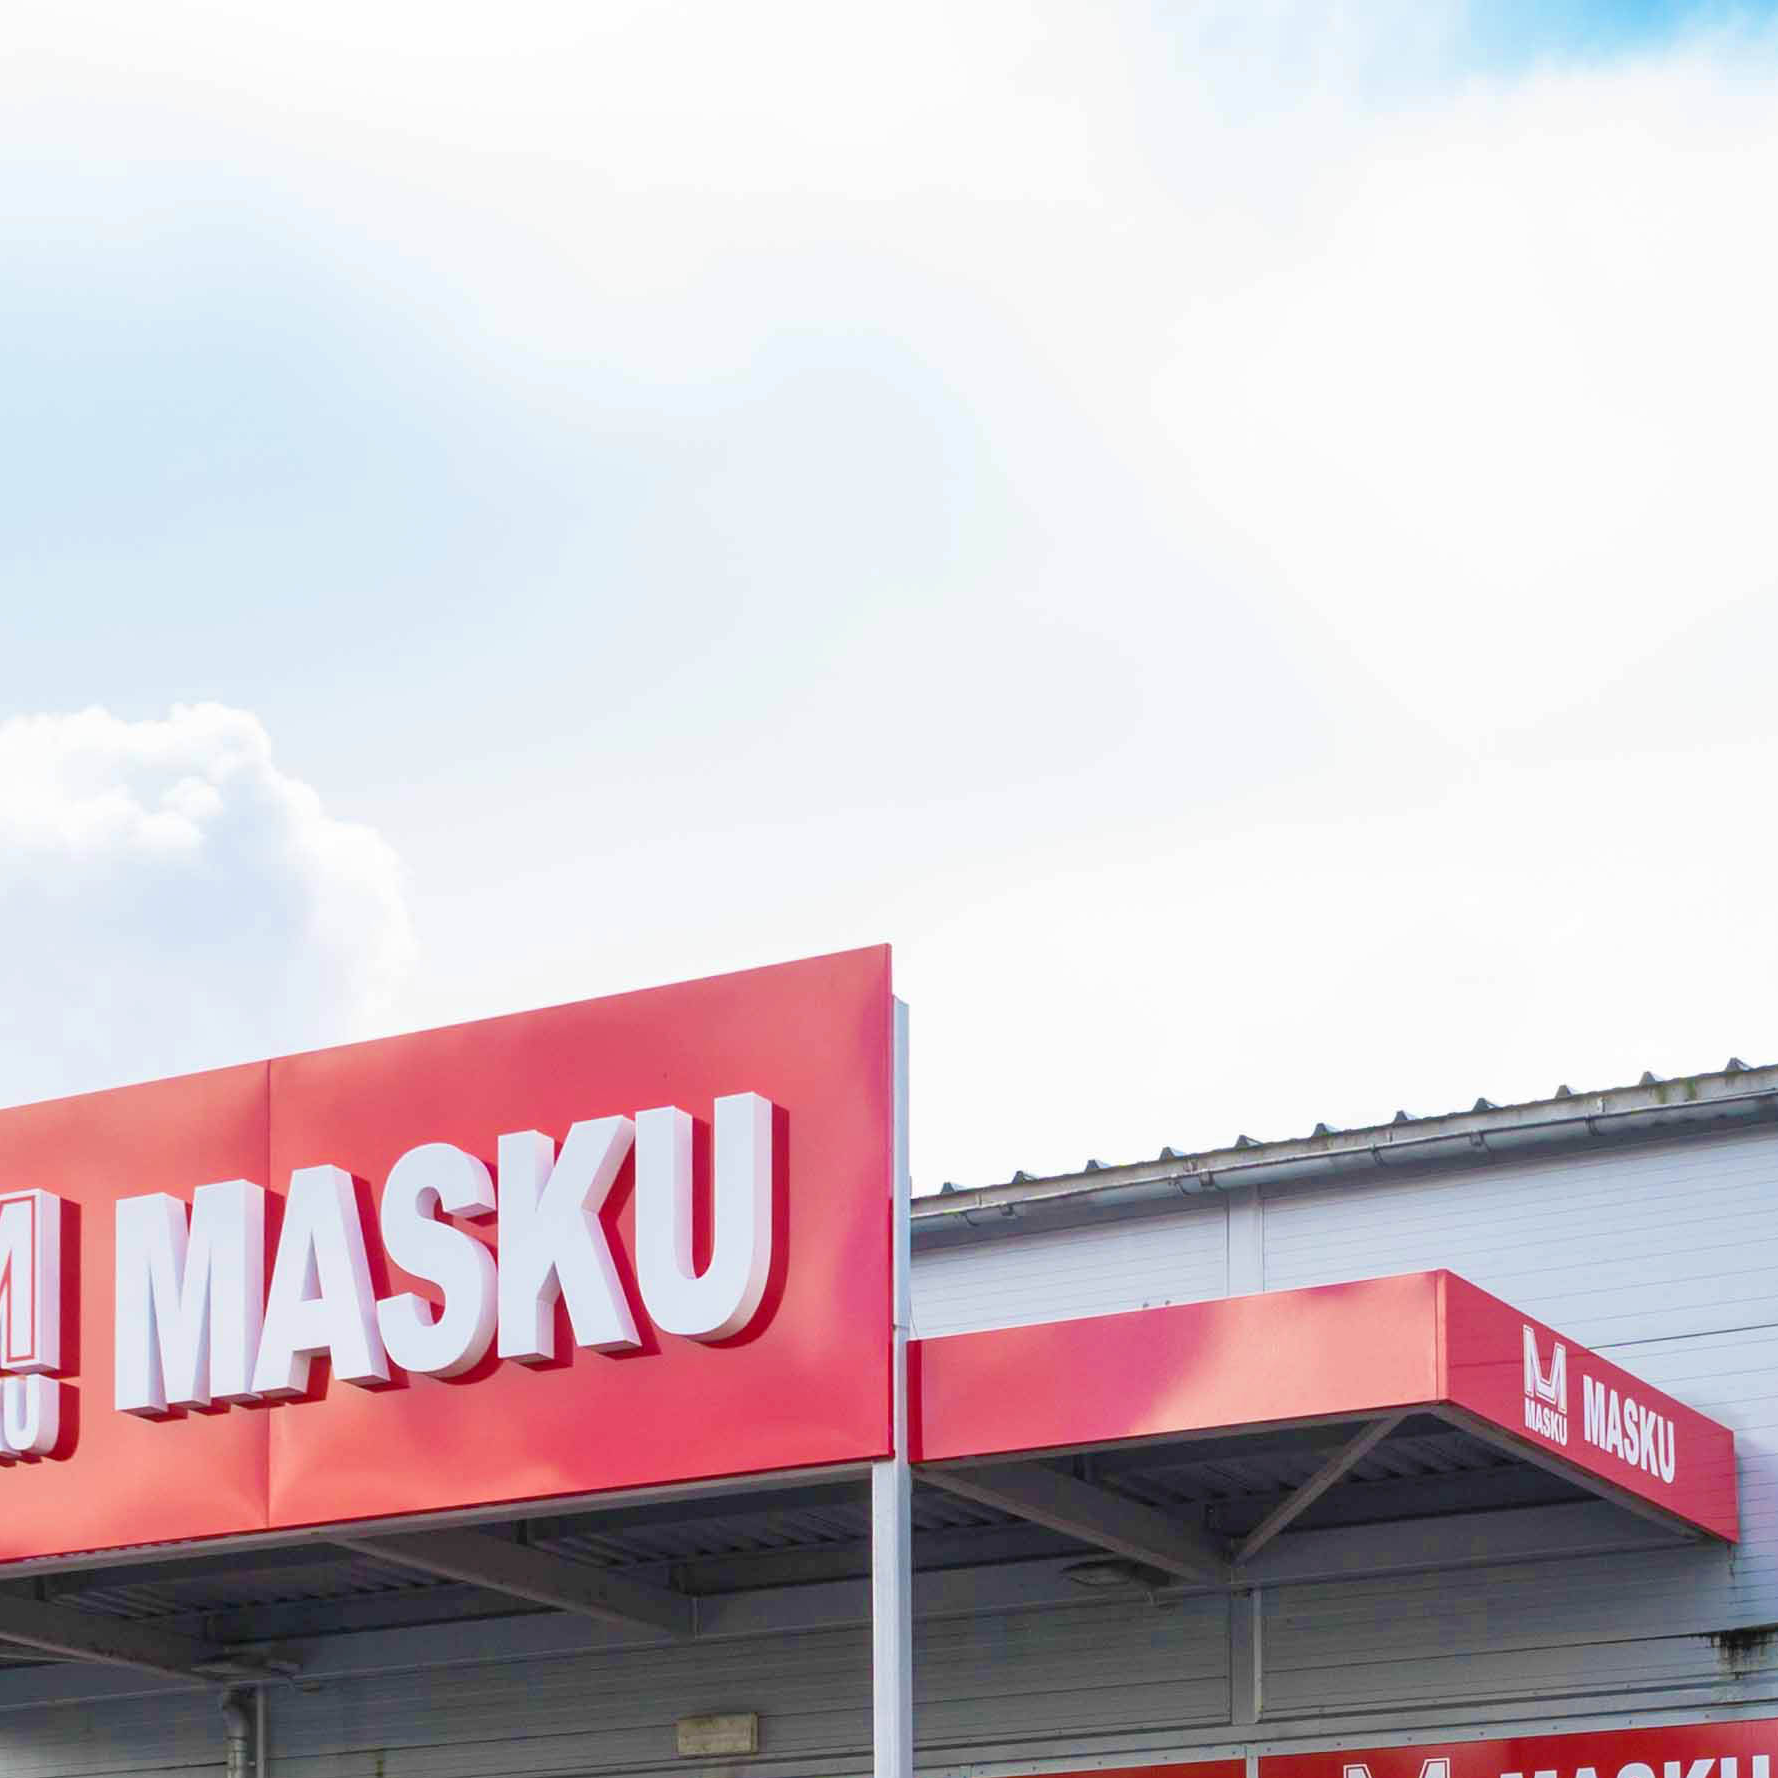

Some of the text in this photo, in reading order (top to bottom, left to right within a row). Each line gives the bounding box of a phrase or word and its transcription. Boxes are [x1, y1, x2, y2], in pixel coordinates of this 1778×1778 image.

[115, 1091, 773, 1416] MASKU
[1525, 1397, 1567, 1446] MASKU
[1583, 1375, 1675, 1484] MASKU
